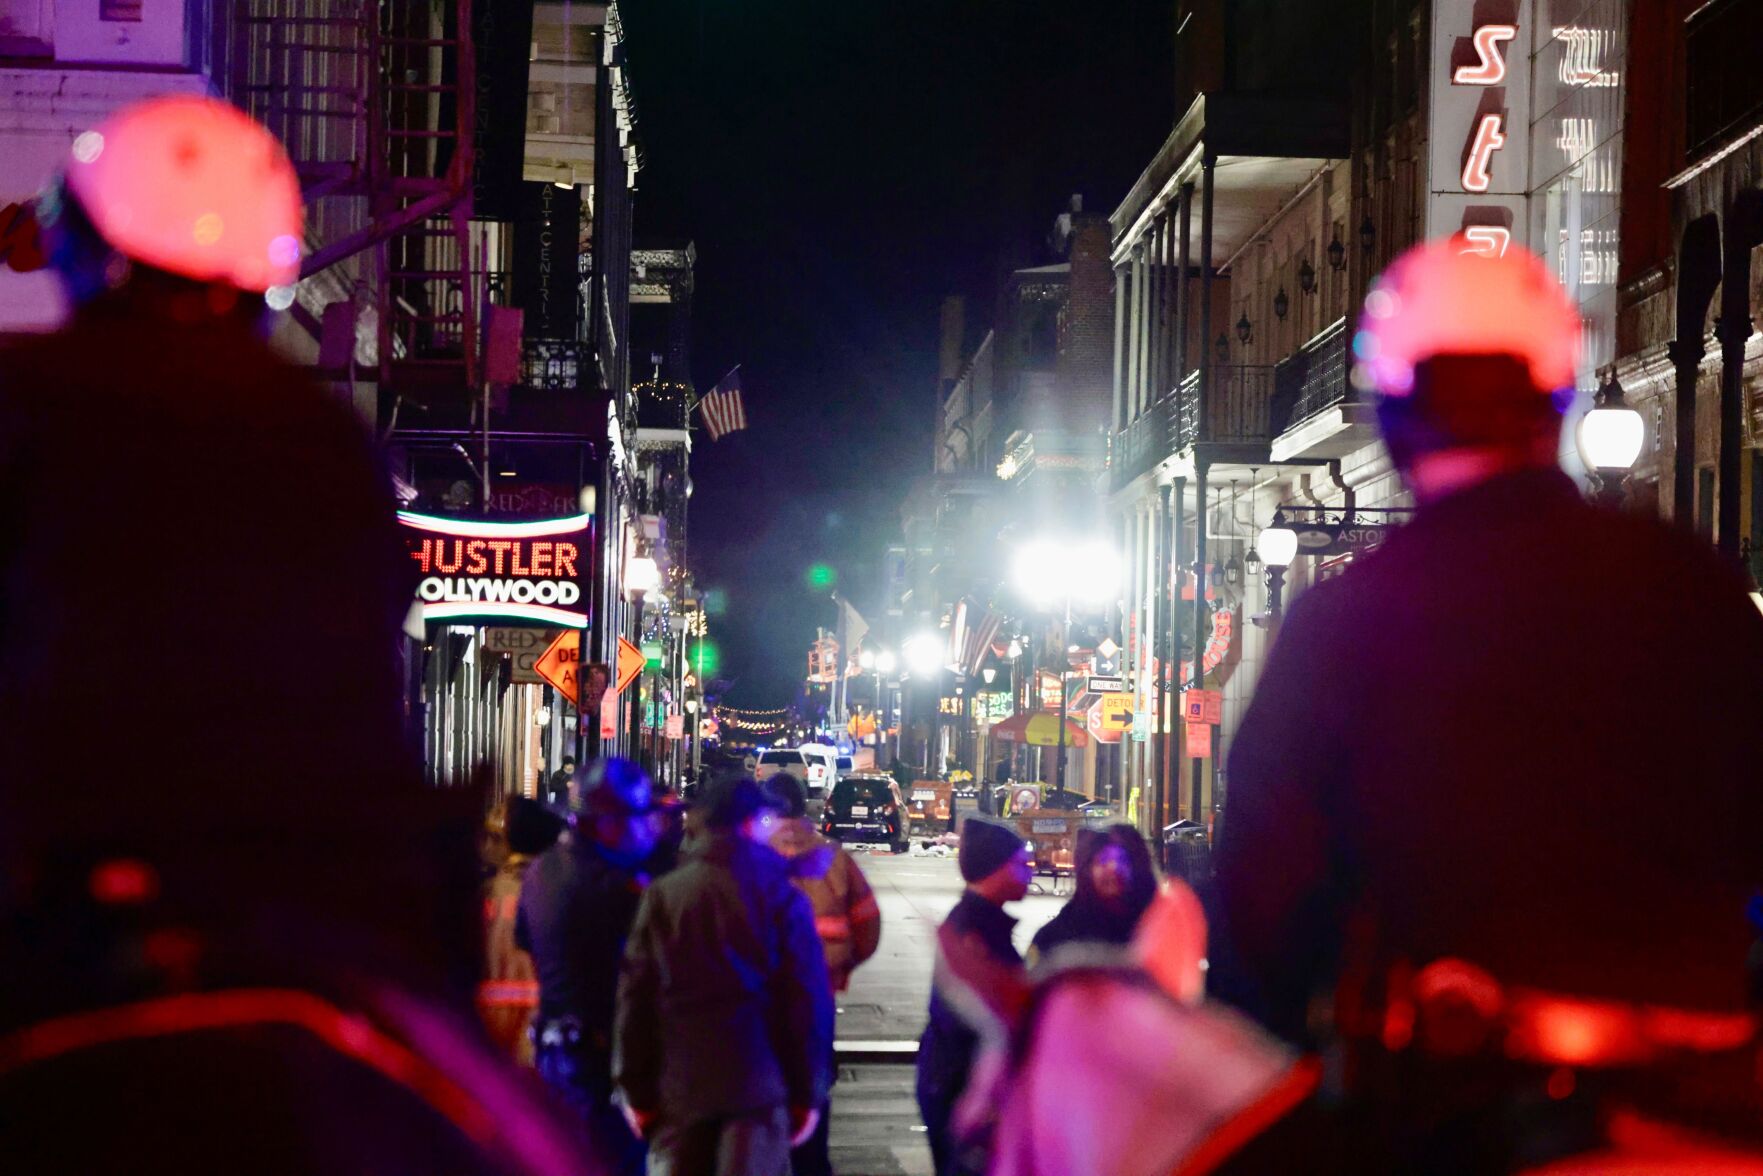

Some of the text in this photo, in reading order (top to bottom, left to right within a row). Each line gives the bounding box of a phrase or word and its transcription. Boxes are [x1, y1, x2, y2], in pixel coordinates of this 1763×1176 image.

[409, 538, 579, 577] HUSTLER
[417, 575, 581, 606] OLLYWOOD
[493, 630, 537, 648] RED
